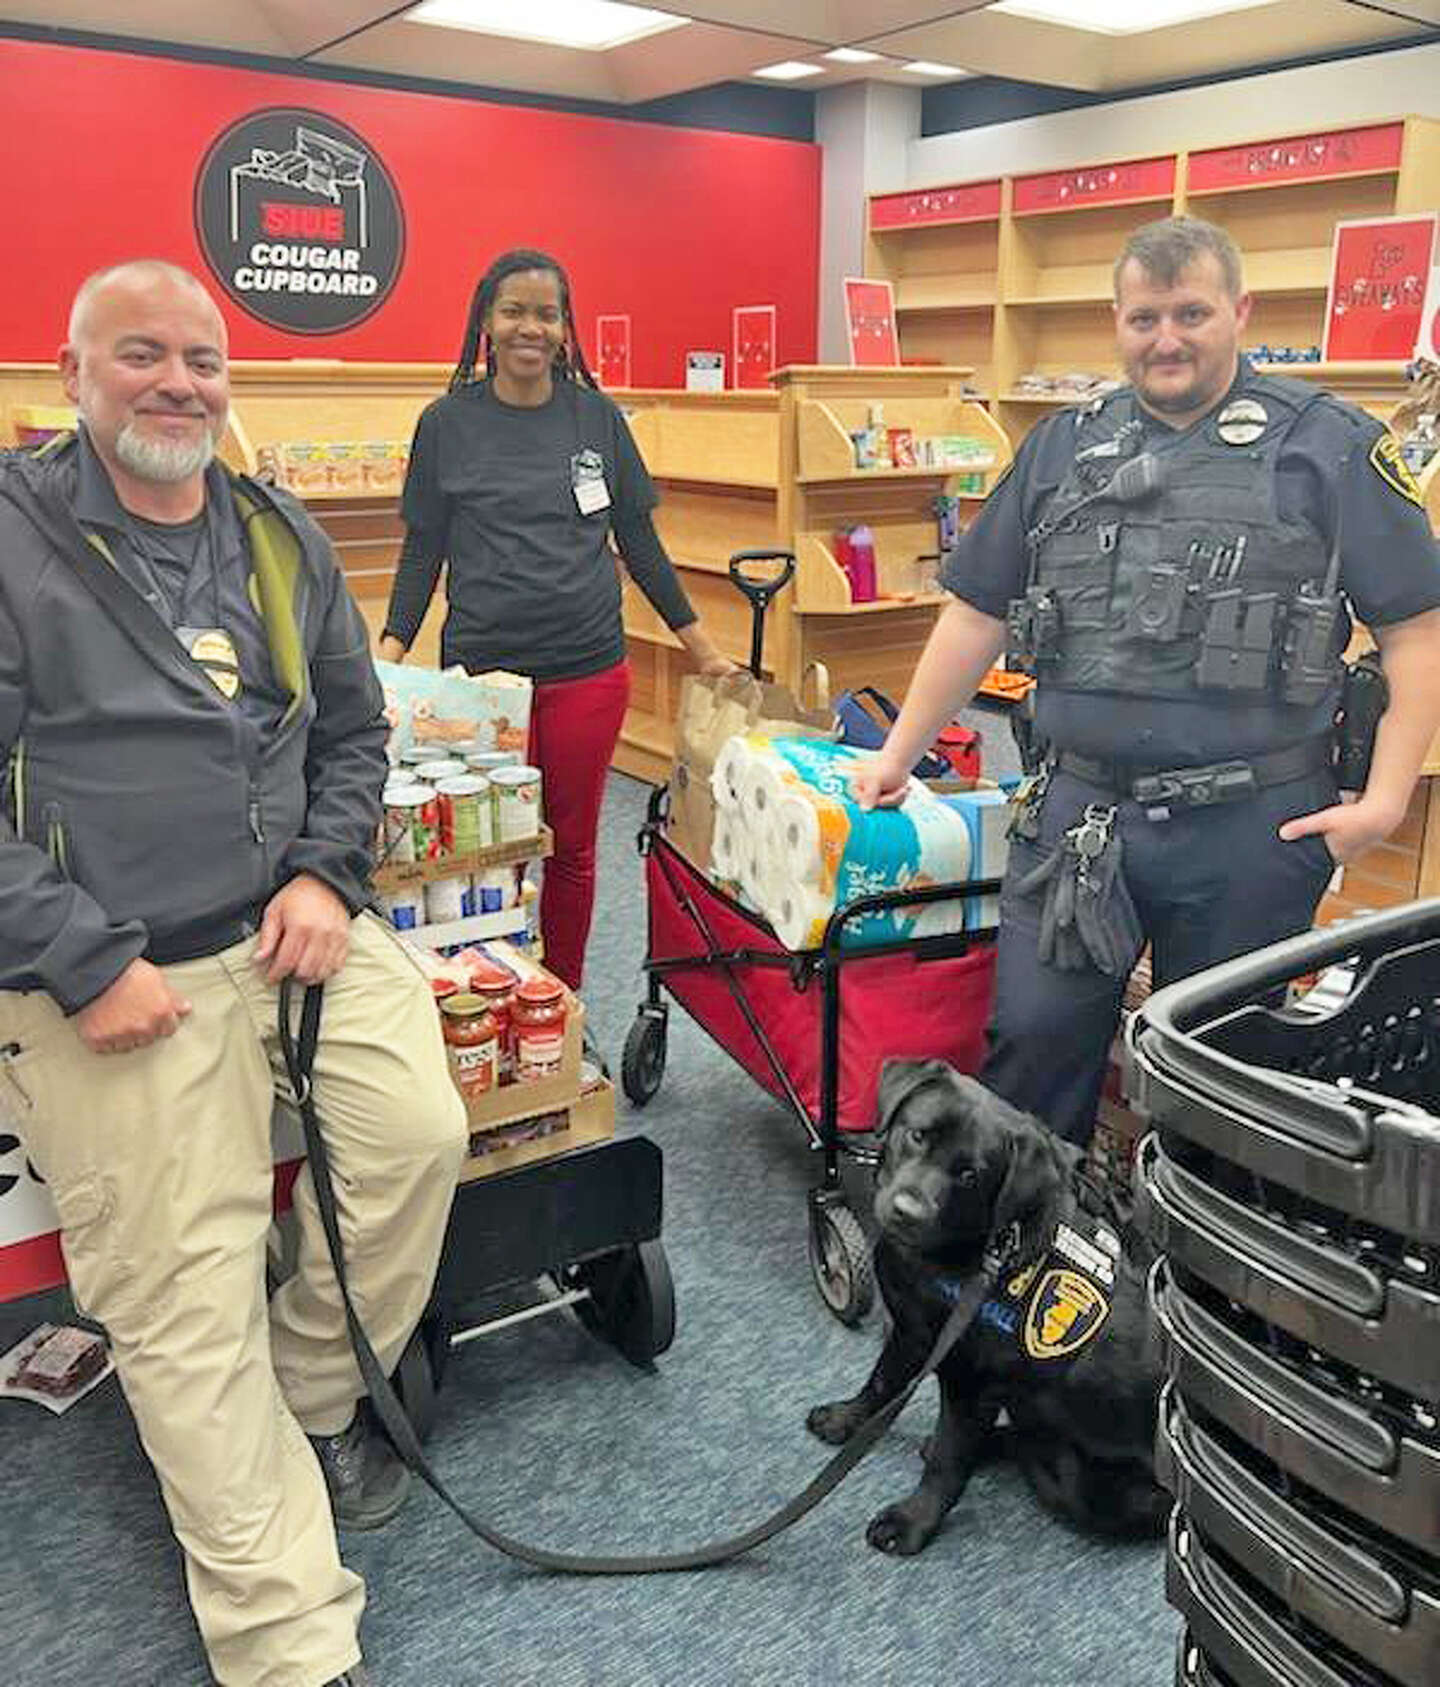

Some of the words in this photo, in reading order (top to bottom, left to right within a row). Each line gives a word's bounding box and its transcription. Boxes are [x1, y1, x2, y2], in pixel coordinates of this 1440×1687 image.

[264, 205, 345, 239] SIUE
[250, 243, 361, 270] COUGAR
[233, 267, 378, 297] CUPBOARD
